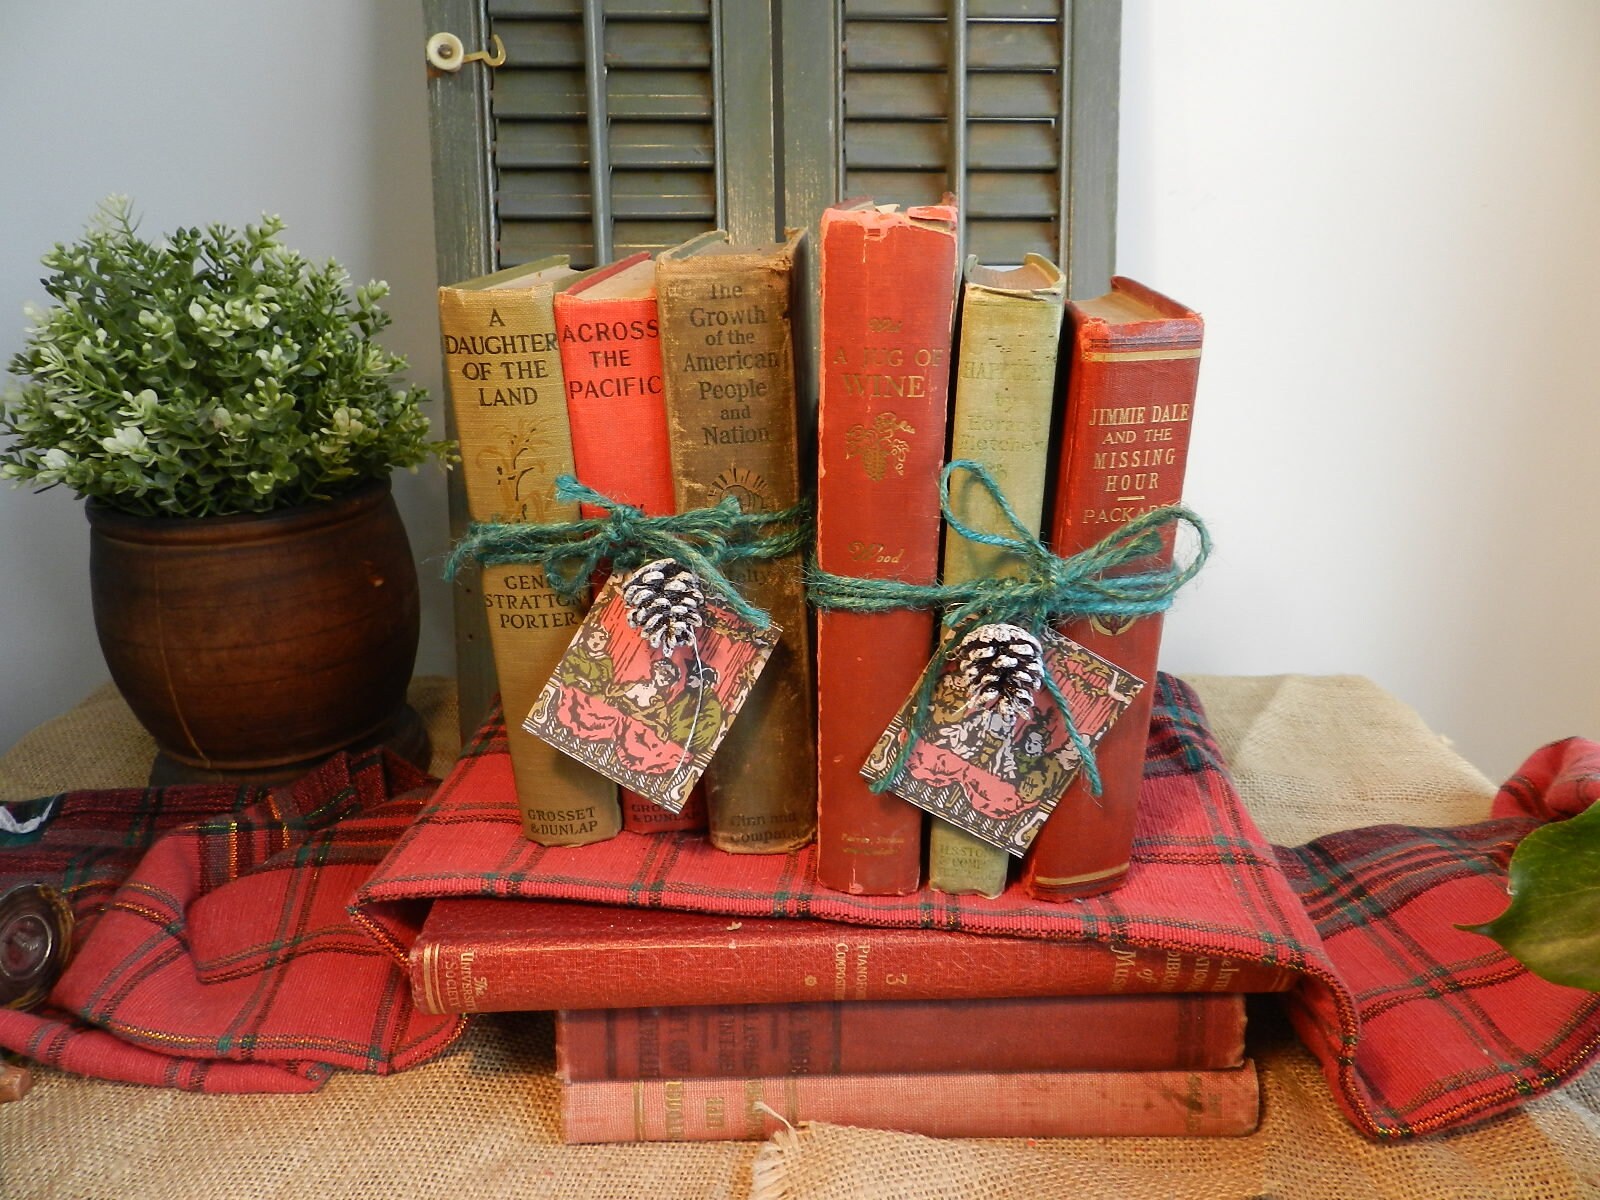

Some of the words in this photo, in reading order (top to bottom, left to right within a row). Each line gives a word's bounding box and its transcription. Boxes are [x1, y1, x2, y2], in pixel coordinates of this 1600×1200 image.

[710, 284, 743, 299] The
[489, 308, 505, 327] A
[690, 305, 768, 327] Growth
[562, 319, 660, 343] ACROSS
[705, 330, 723, 346] of
[728, 330, 755, 344] the
[444, 333, 558, 355] DAUGHTER
[589, 350, 631, 368] THE
[683, 350, 780, 372] American
[833, 346, 848, 365] A
[914, 348, 944, 367] OF
[462, 362, 492, 381] OF
[500, 360, 549, 380] THE
[569, 375, 662, 400] PACIFIC
[699, 379, 768, 402] People
[842, 373, 925, 398] WINE
[479, 387, 538, 407] LAND
[720, 405, 751, 421] and
[1088, 406, 1145, 426] JIMMIE
[1151, 403, 1190, 423] DALE
[703, 425, 770, 446] Nation
[1102, 431, 1137, 445] AND
[1144, 428, 1173, 442] THE
[1093, 448, 1176, 470] MISSING
[1105, 472, 1159, 492] HOUR
[504, 575, 545, 590] GEN
[500, 612, 578, 629] PORTER
[527, 807, 596, 822] GROSSET
[473, 975, 489, 997] The
[886, 973, 908, 986] 3
[1137, 968, 1157, 985] of
